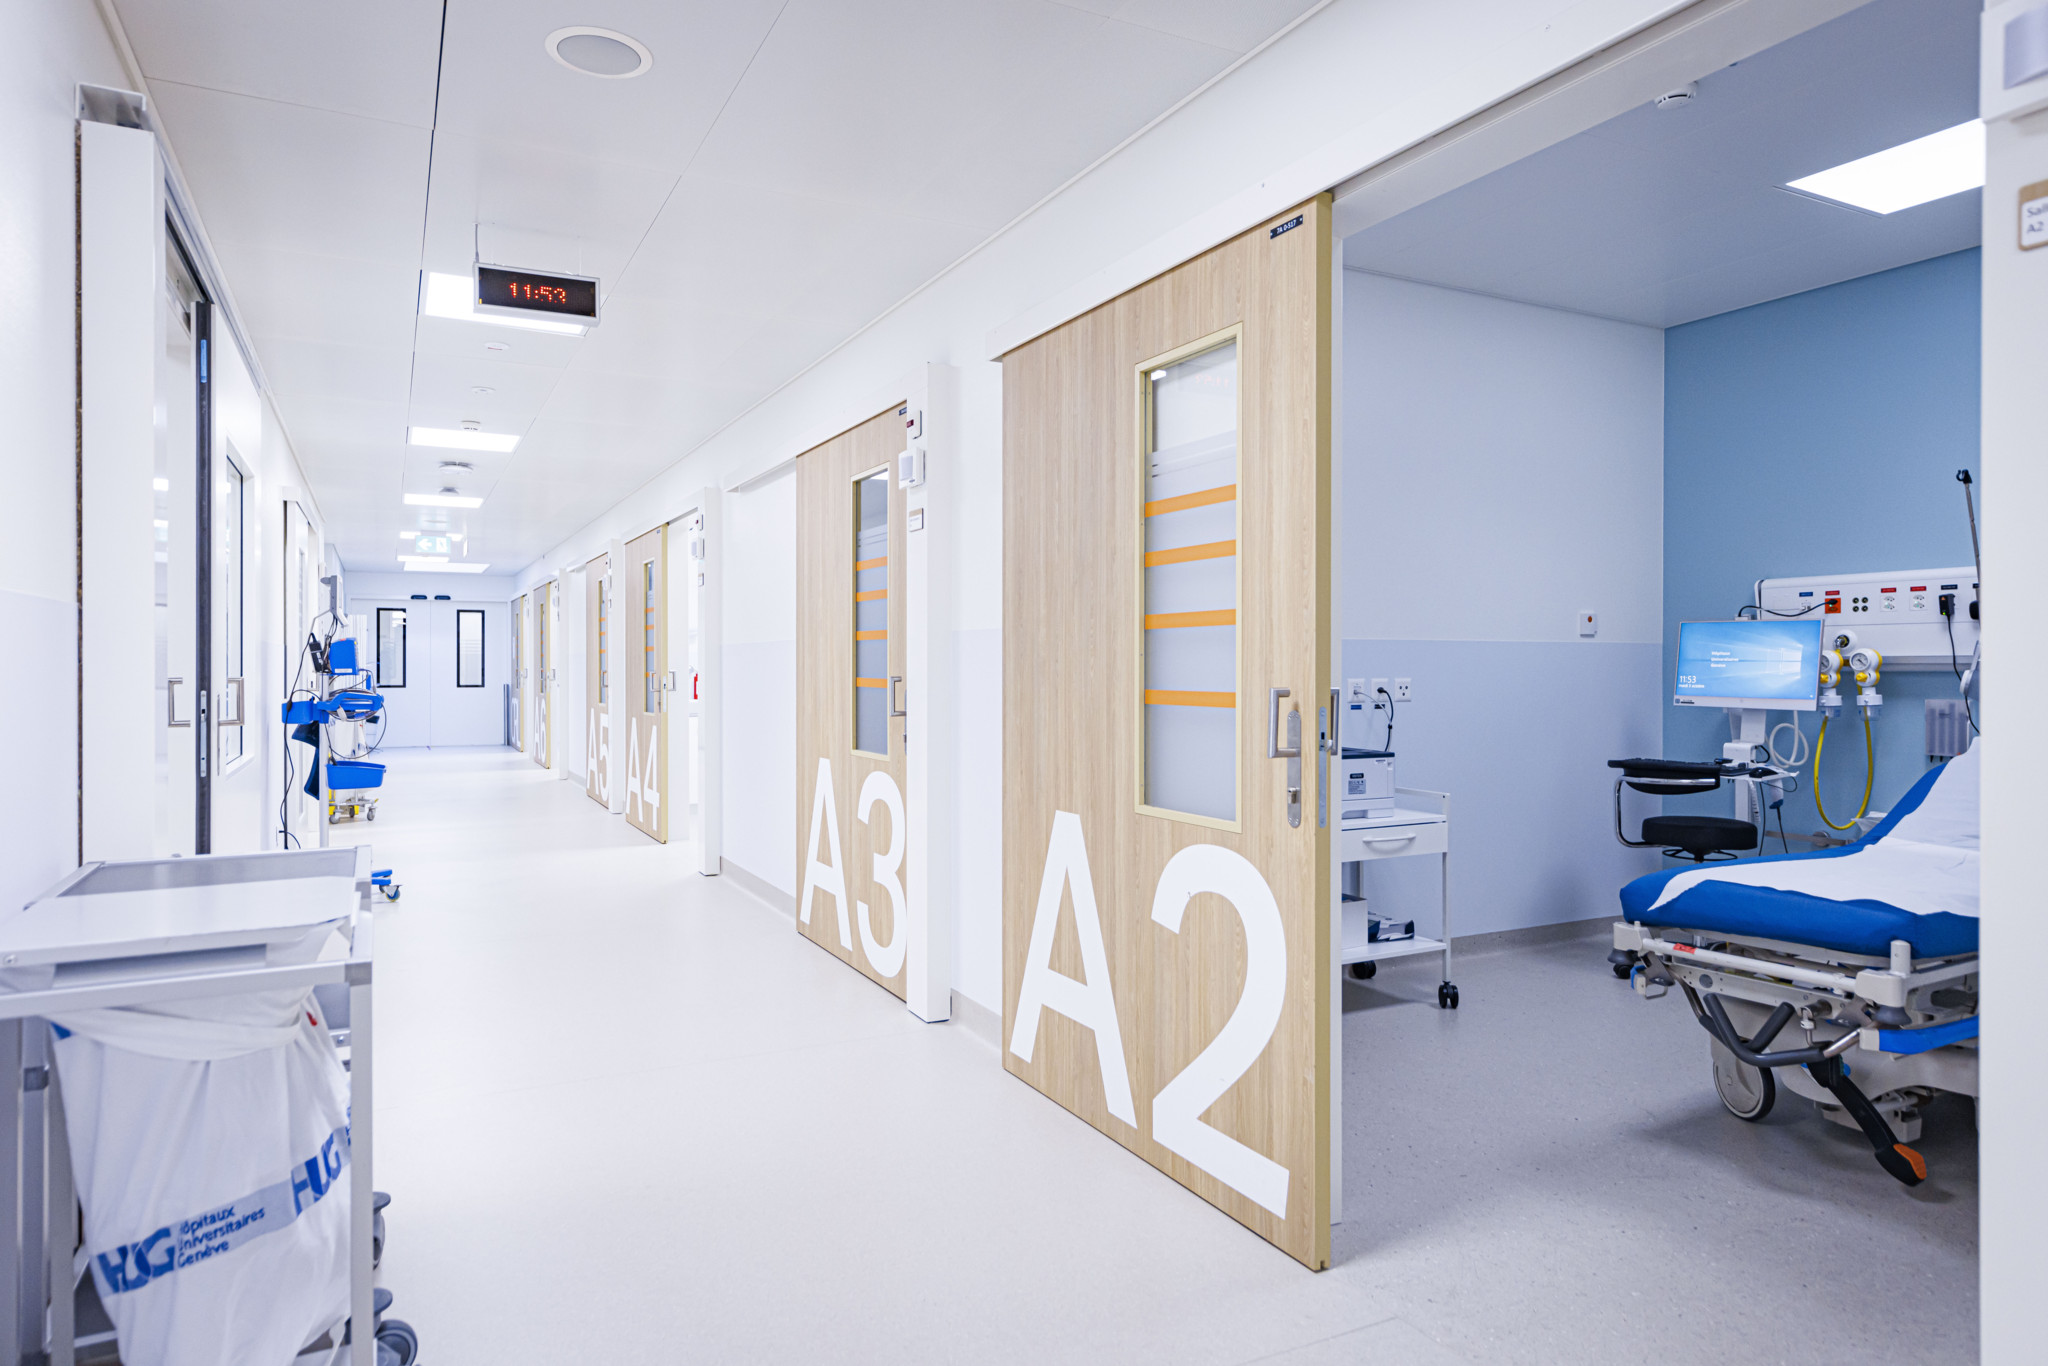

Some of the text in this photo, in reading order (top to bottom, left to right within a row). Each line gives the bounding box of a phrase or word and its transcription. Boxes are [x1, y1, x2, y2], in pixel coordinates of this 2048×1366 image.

[2026, 221, 2044, 234] A2
[509, 282, 567, 304] 11:53
[1679, 675, 1697, 684] 11:53
[533, 696, 547, 764] A6
[586, 707, 609, 801] A5
[626, 717, 660, 832] A4
[800, 757, 907, 978] A3
[1009, 810, 1290, 1220] A2
[97, 1227, 175, 1294] HUG
